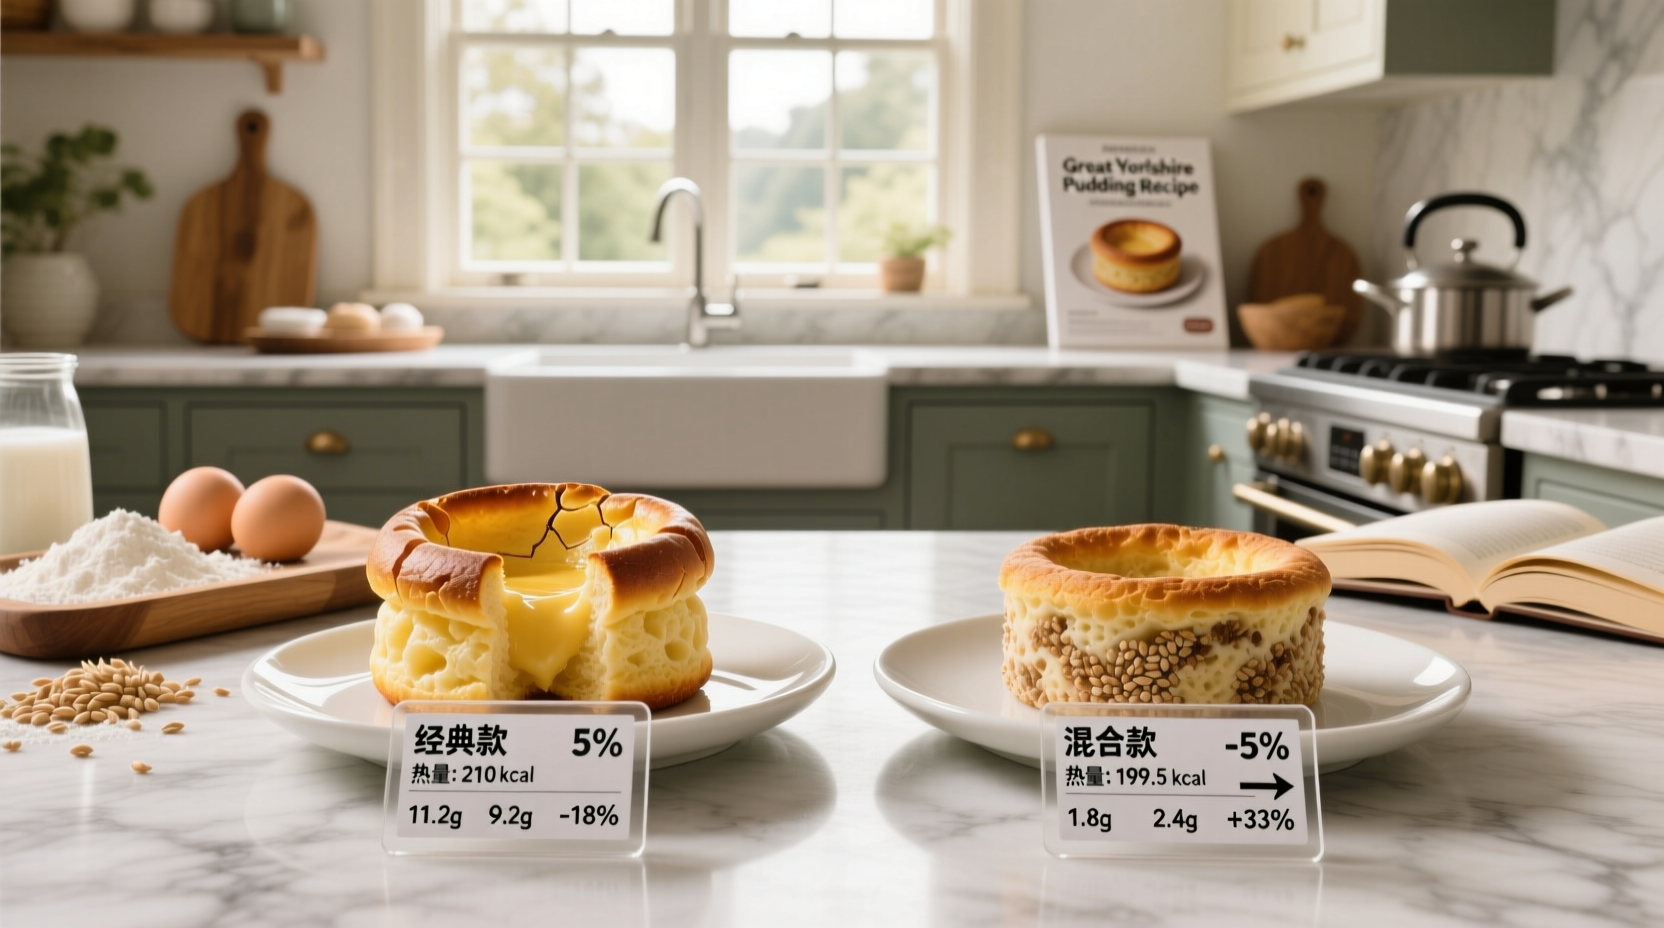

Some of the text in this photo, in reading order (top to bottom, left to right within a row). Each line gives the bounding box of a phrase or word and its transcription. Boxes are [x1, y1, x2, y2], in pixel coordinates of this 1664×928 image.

[1063, 157, 1112, 174] Great
[1063, 177, 1199, 198] Pudding Recipe
[413, 723, 508, 757] 经典款
[571, 727, 623, 758] 5%
[1063, 725, 1158, 759] 混合款
[1225, 731, 1290, 761] -5%
[461, 765, 497, 784] 210
[499, 765, 535, 783] kcal
[1116, 767, 1168, 787] 199.5
[1171, 768, 1206, 787] kcal
[409, 804, 619, 831] 11.2g 9.2g -18%
[1068, 807, 1295, 834] 1.8g 2.4g +33%
